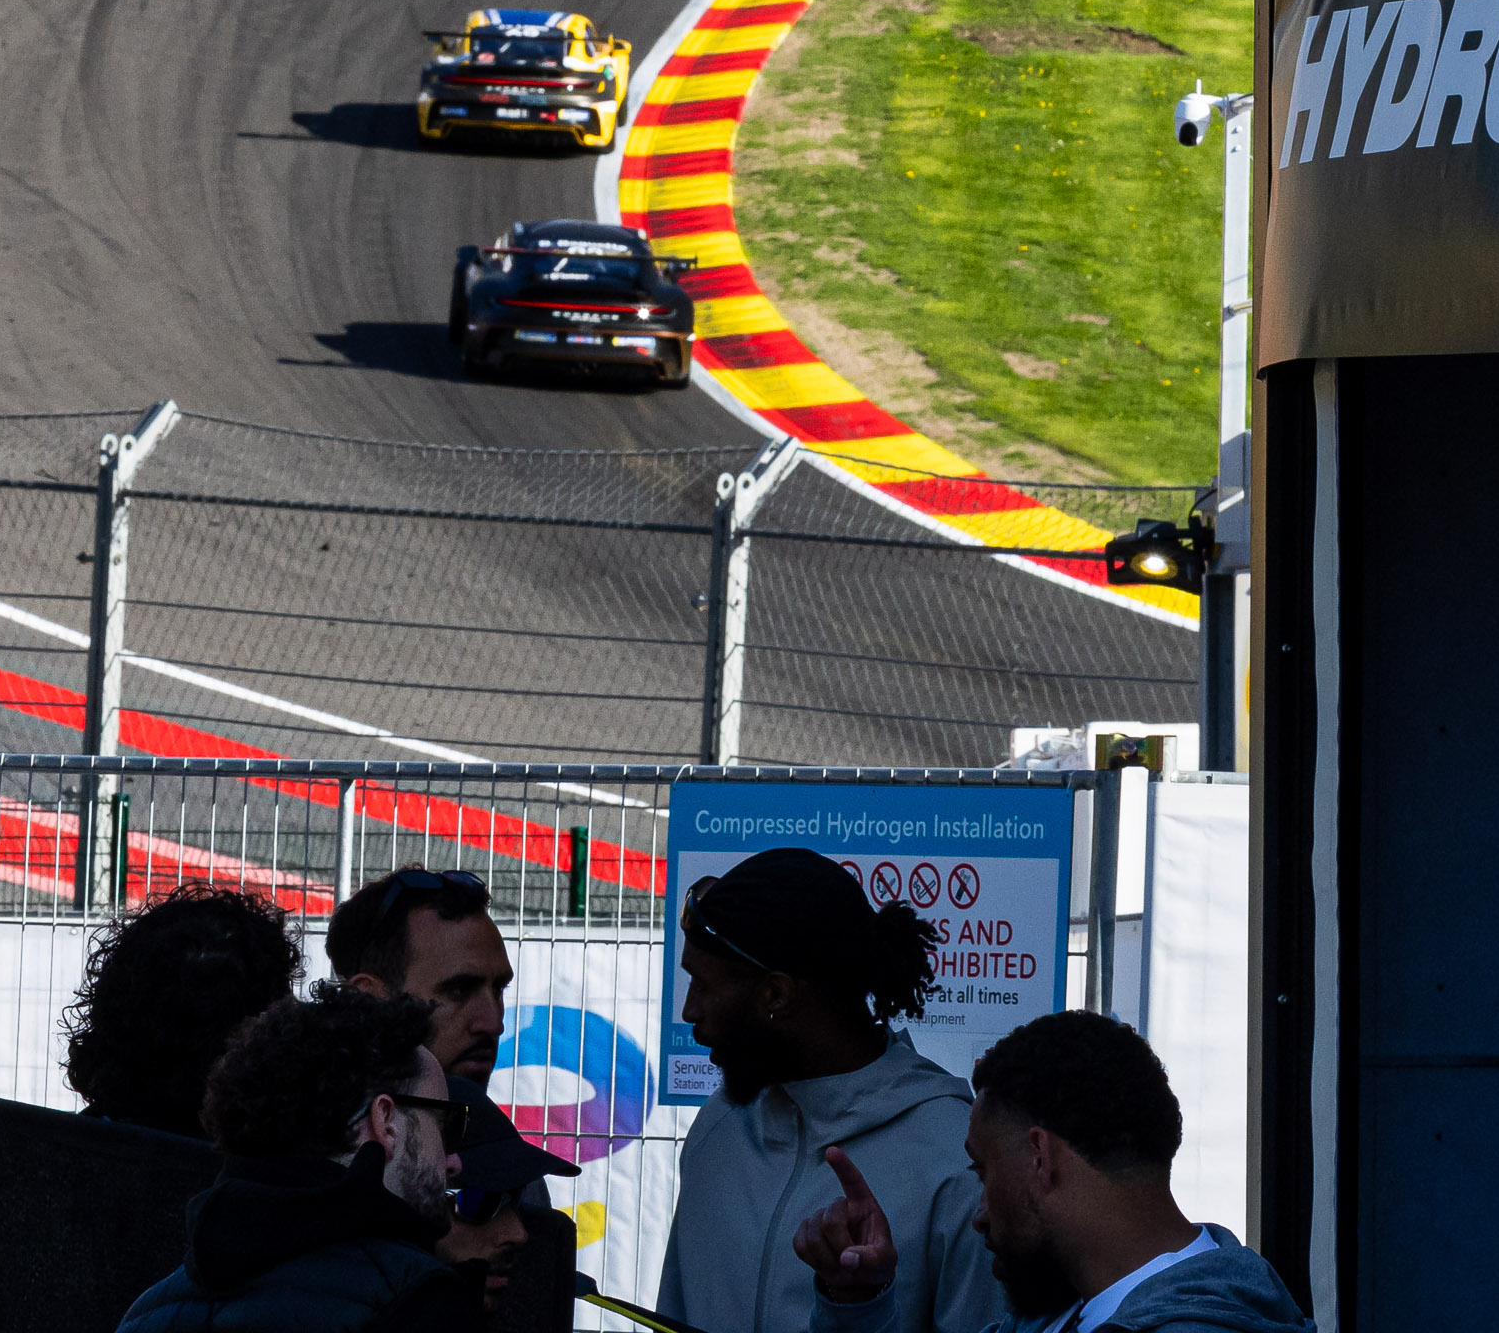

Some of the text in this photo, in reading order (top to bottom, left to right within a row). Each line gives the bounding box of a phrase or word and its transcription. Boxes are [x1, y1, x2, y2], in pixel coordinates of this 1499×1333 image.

[695, 809, 1044, 844] Compressed Hydrogen Installation
[958, 919, 1013, 946] AND
[926, 951, 1037, 979] OHIBITED
[938, 987, 953, 1003] at
[957, 984, 974, 1004] all
[978, 986, 1019, 1005] times
[672, 1031, 683, 1046] In
[674, 1060, 713, 1076] Service
[673, 1077, 705, 1090] Station
